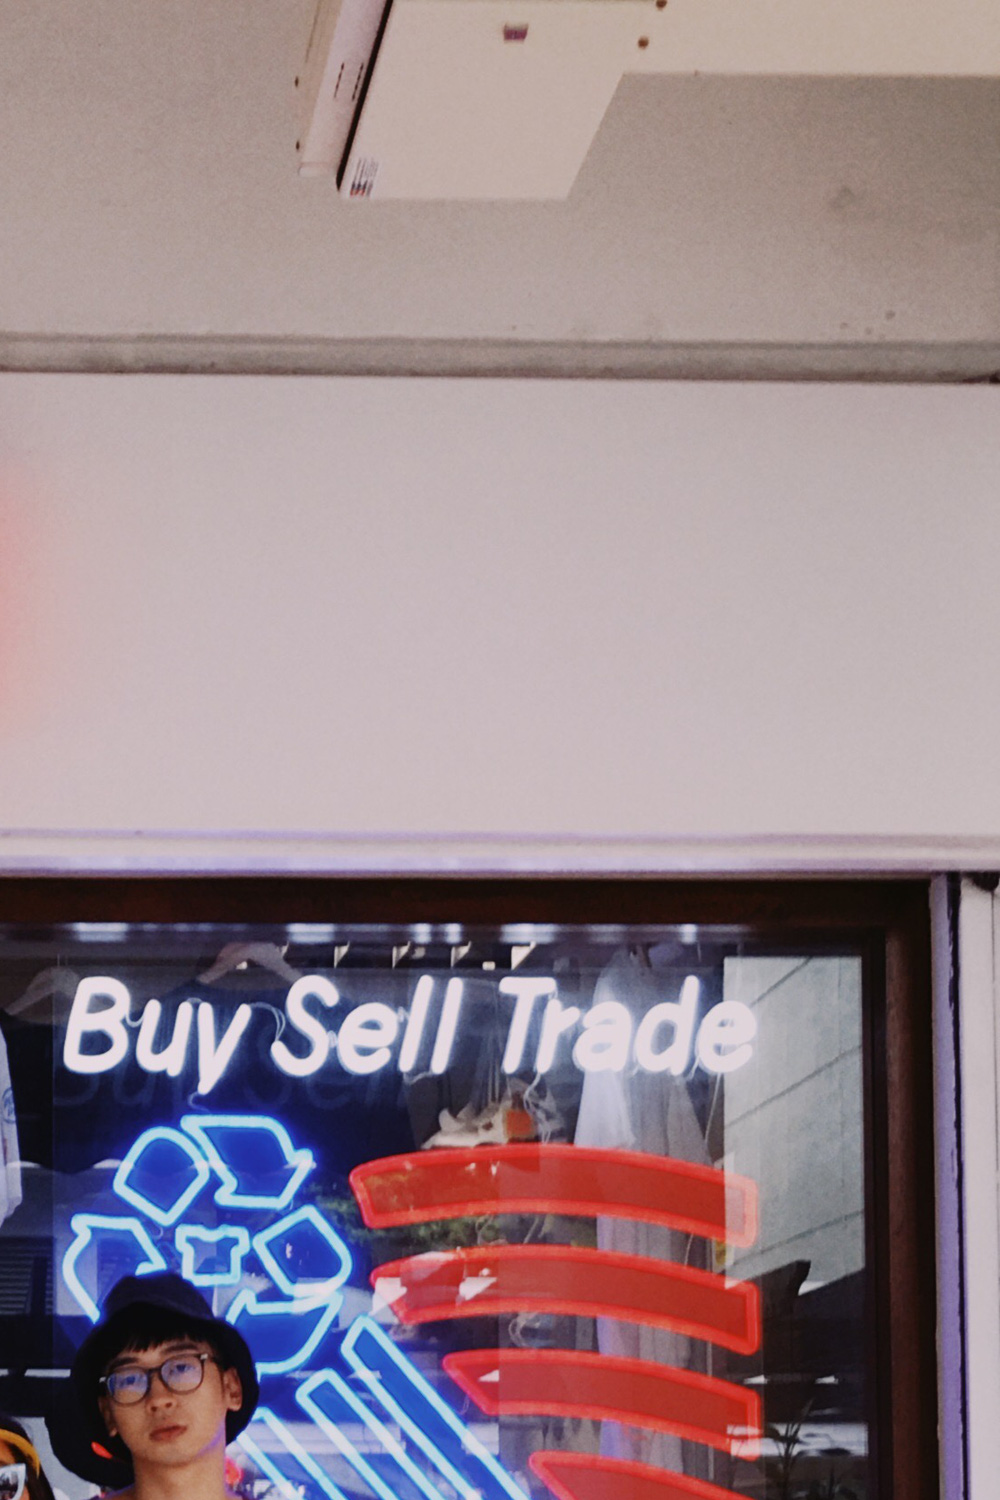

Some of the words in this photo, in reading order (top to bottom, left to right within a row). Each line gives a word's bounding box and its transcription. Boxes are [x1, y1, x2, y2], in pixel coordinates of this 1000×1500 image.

[62, 975, 252, 1095] Buy
[270, 974, 464, 1077] Sell
[499, 974, 760, 1076] Trade
